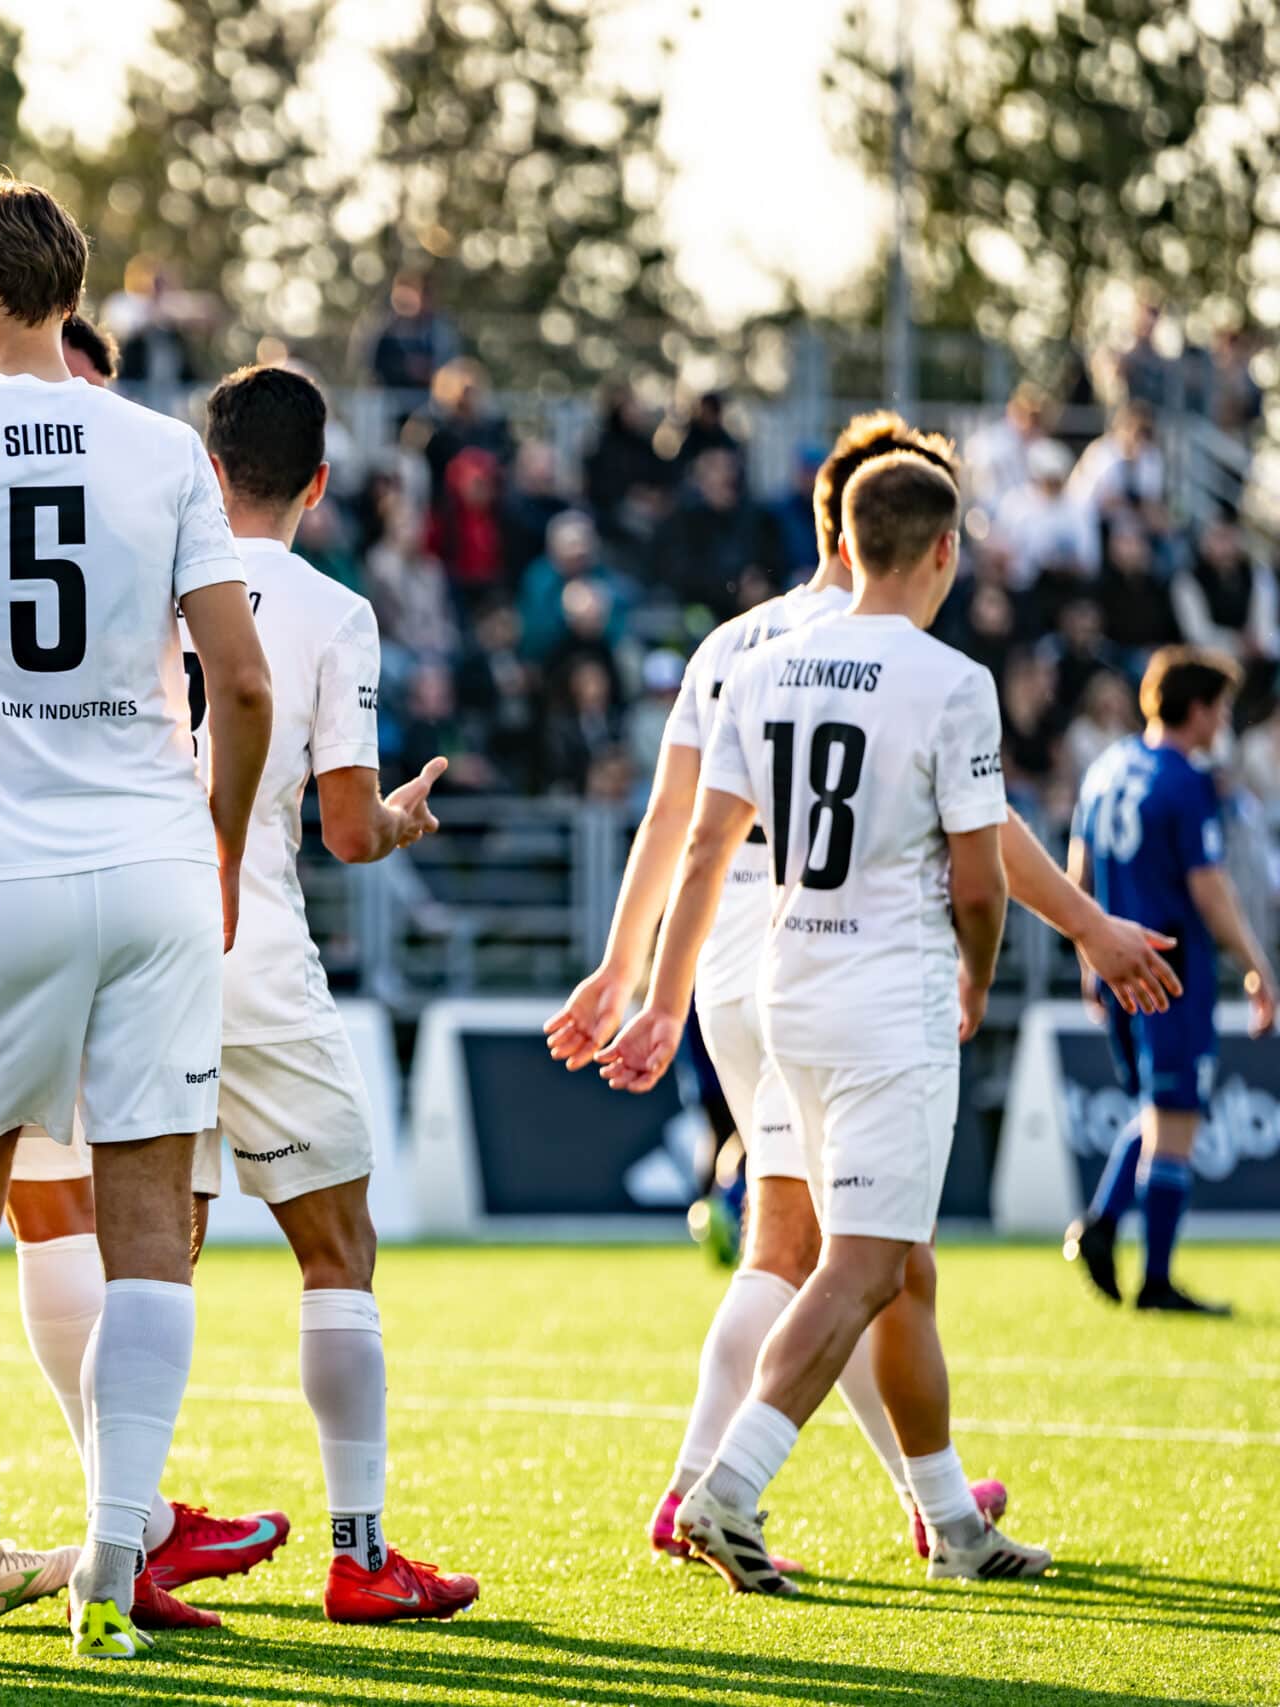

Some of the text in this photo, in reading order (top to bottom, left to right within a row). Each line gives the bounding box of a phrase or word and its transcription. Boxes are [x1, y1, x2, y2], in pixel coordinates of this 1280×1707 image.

[4, 423, 87, 457] SLIEDE
[9, 485, 87, 673] 5
[778, 658, 882, 692] ZELENKOVS
[1, 700, 138, 720] LNK INDUSTRIES
[763, 720, 867, 891] 18
[233, 1141, 311, 1164] teamsport.lv
